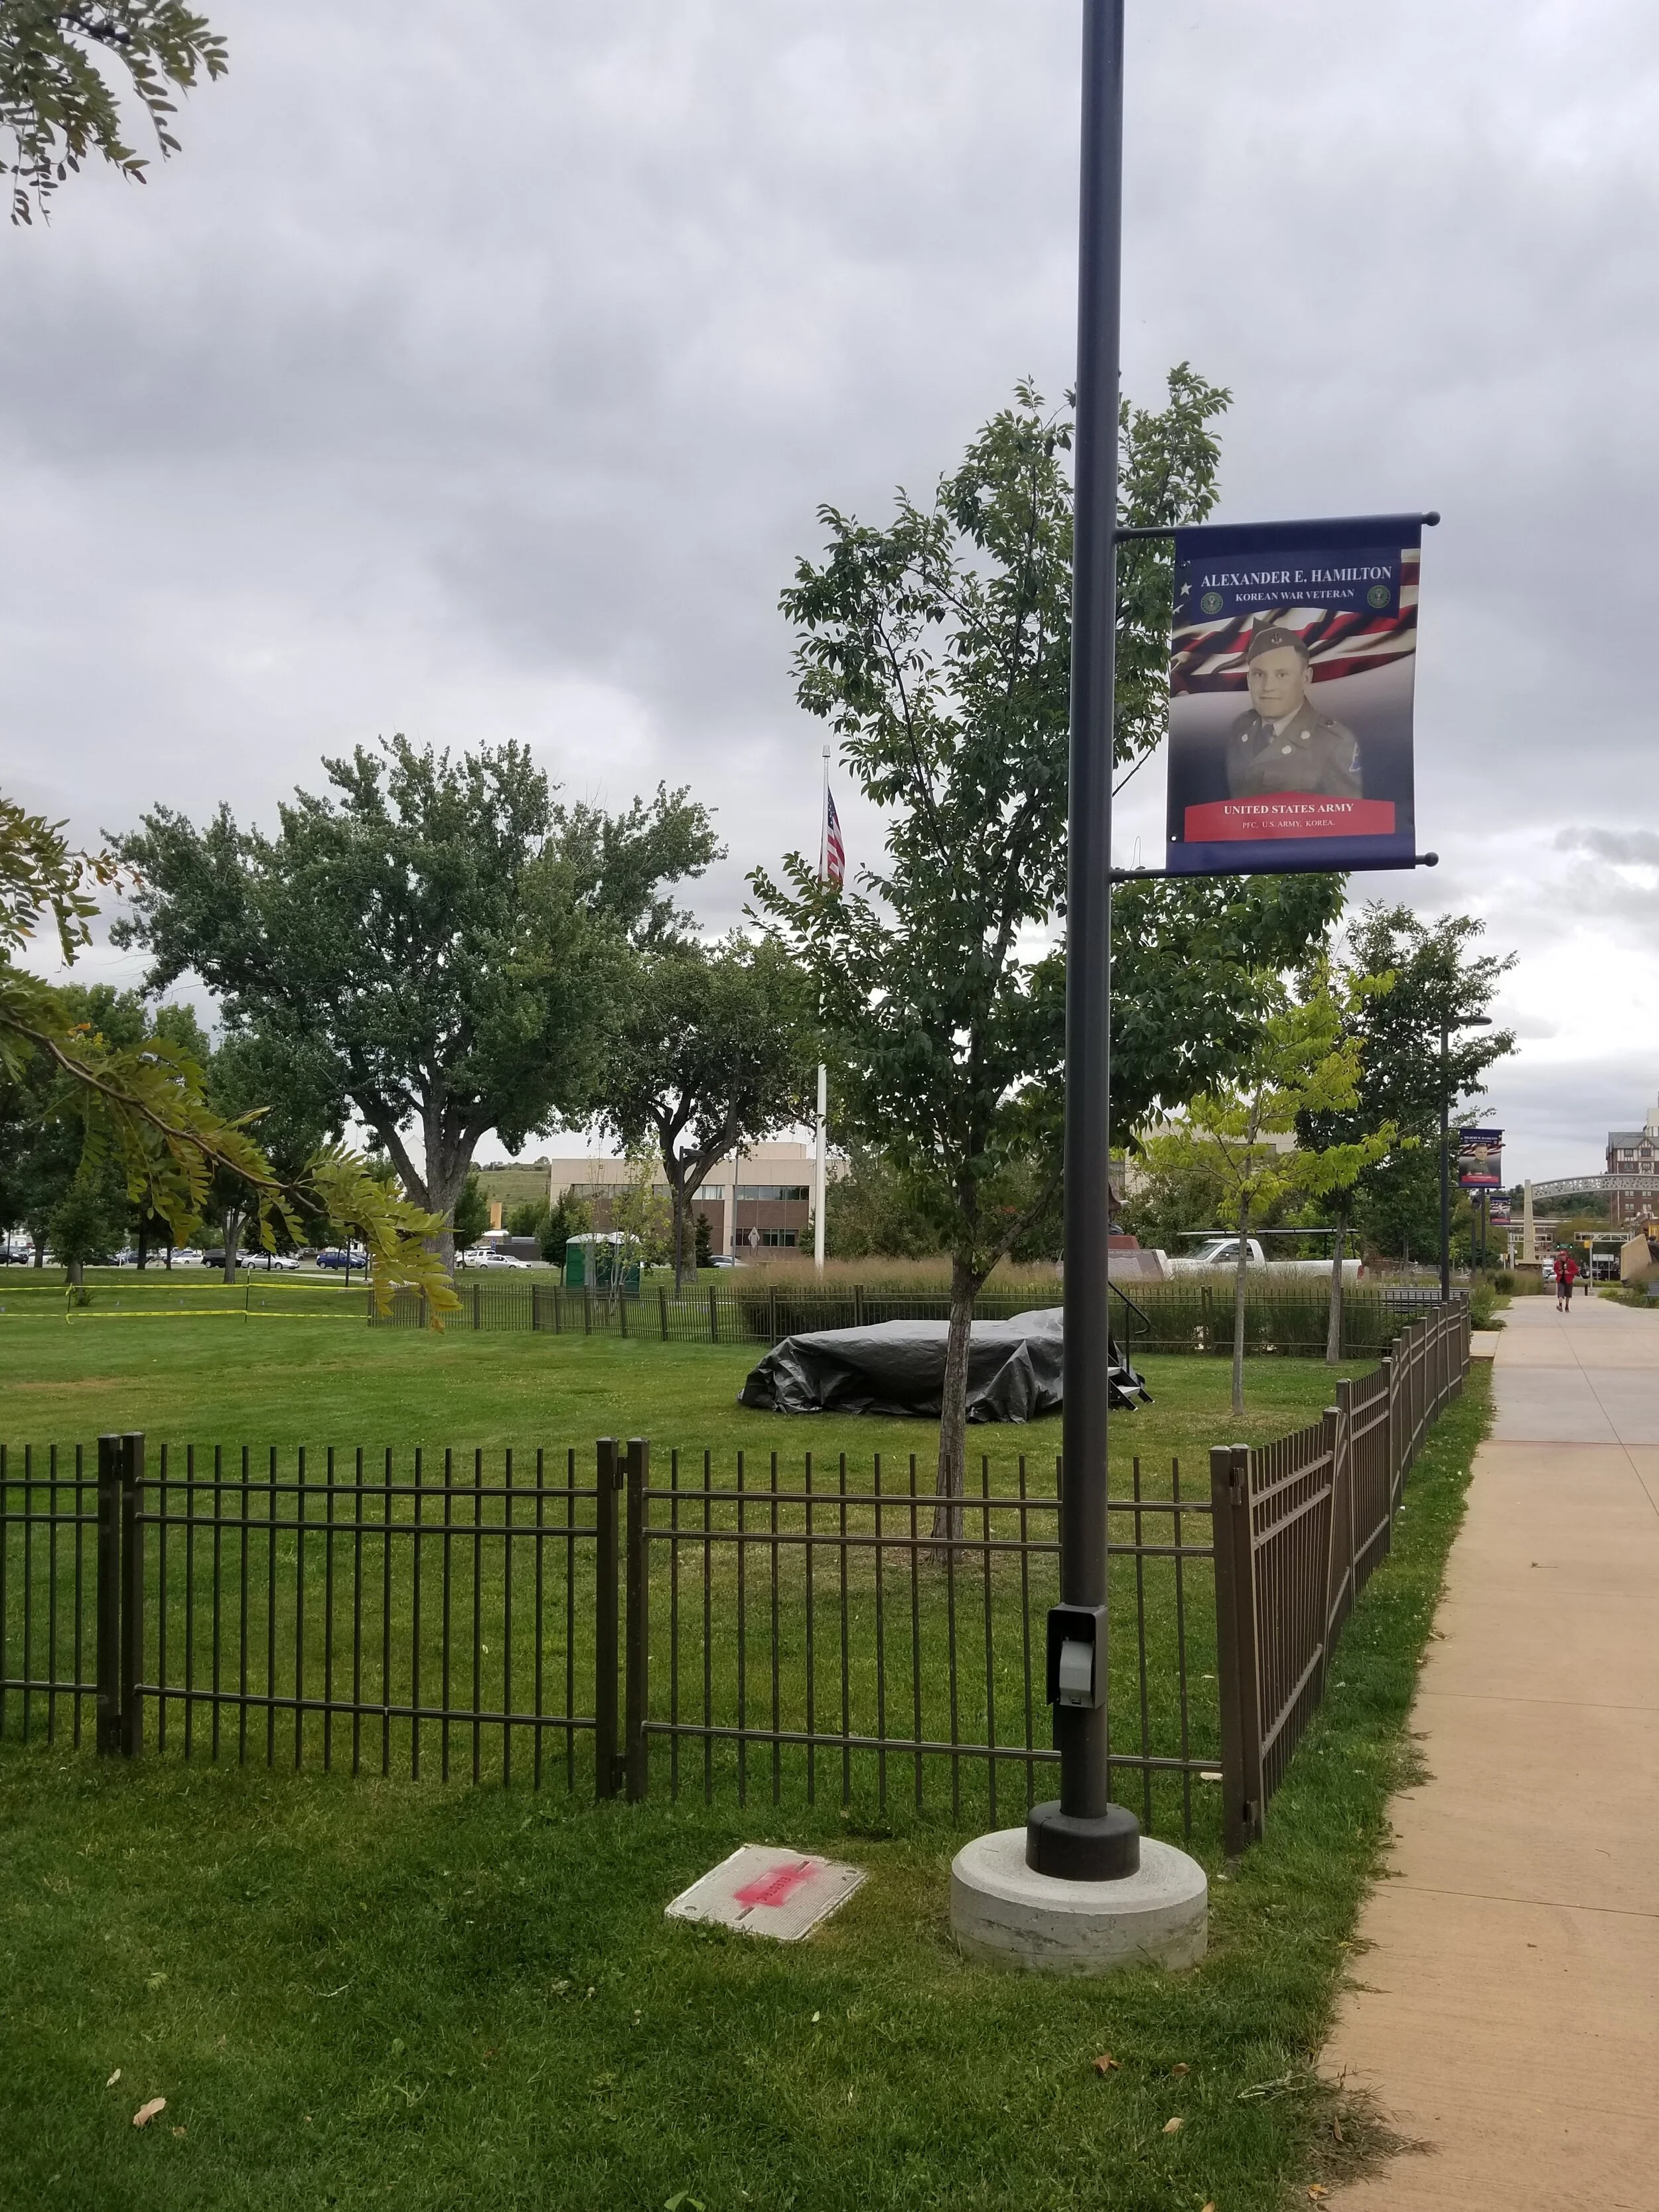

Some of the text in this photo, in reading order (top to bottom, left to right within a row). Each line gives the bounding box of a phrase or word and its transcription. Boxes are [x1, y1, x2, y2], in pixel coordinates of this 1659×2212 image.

[1200, 566, 1392, 587] ALEXANDER E. HAMILTON
[1236, 589, 1354, 602] KOREAN WAR VETERAN
[1224, 803, 1354, 815] UNITED STATES ARMY
[756, 1876, 792, 1901] ELECTRIC
